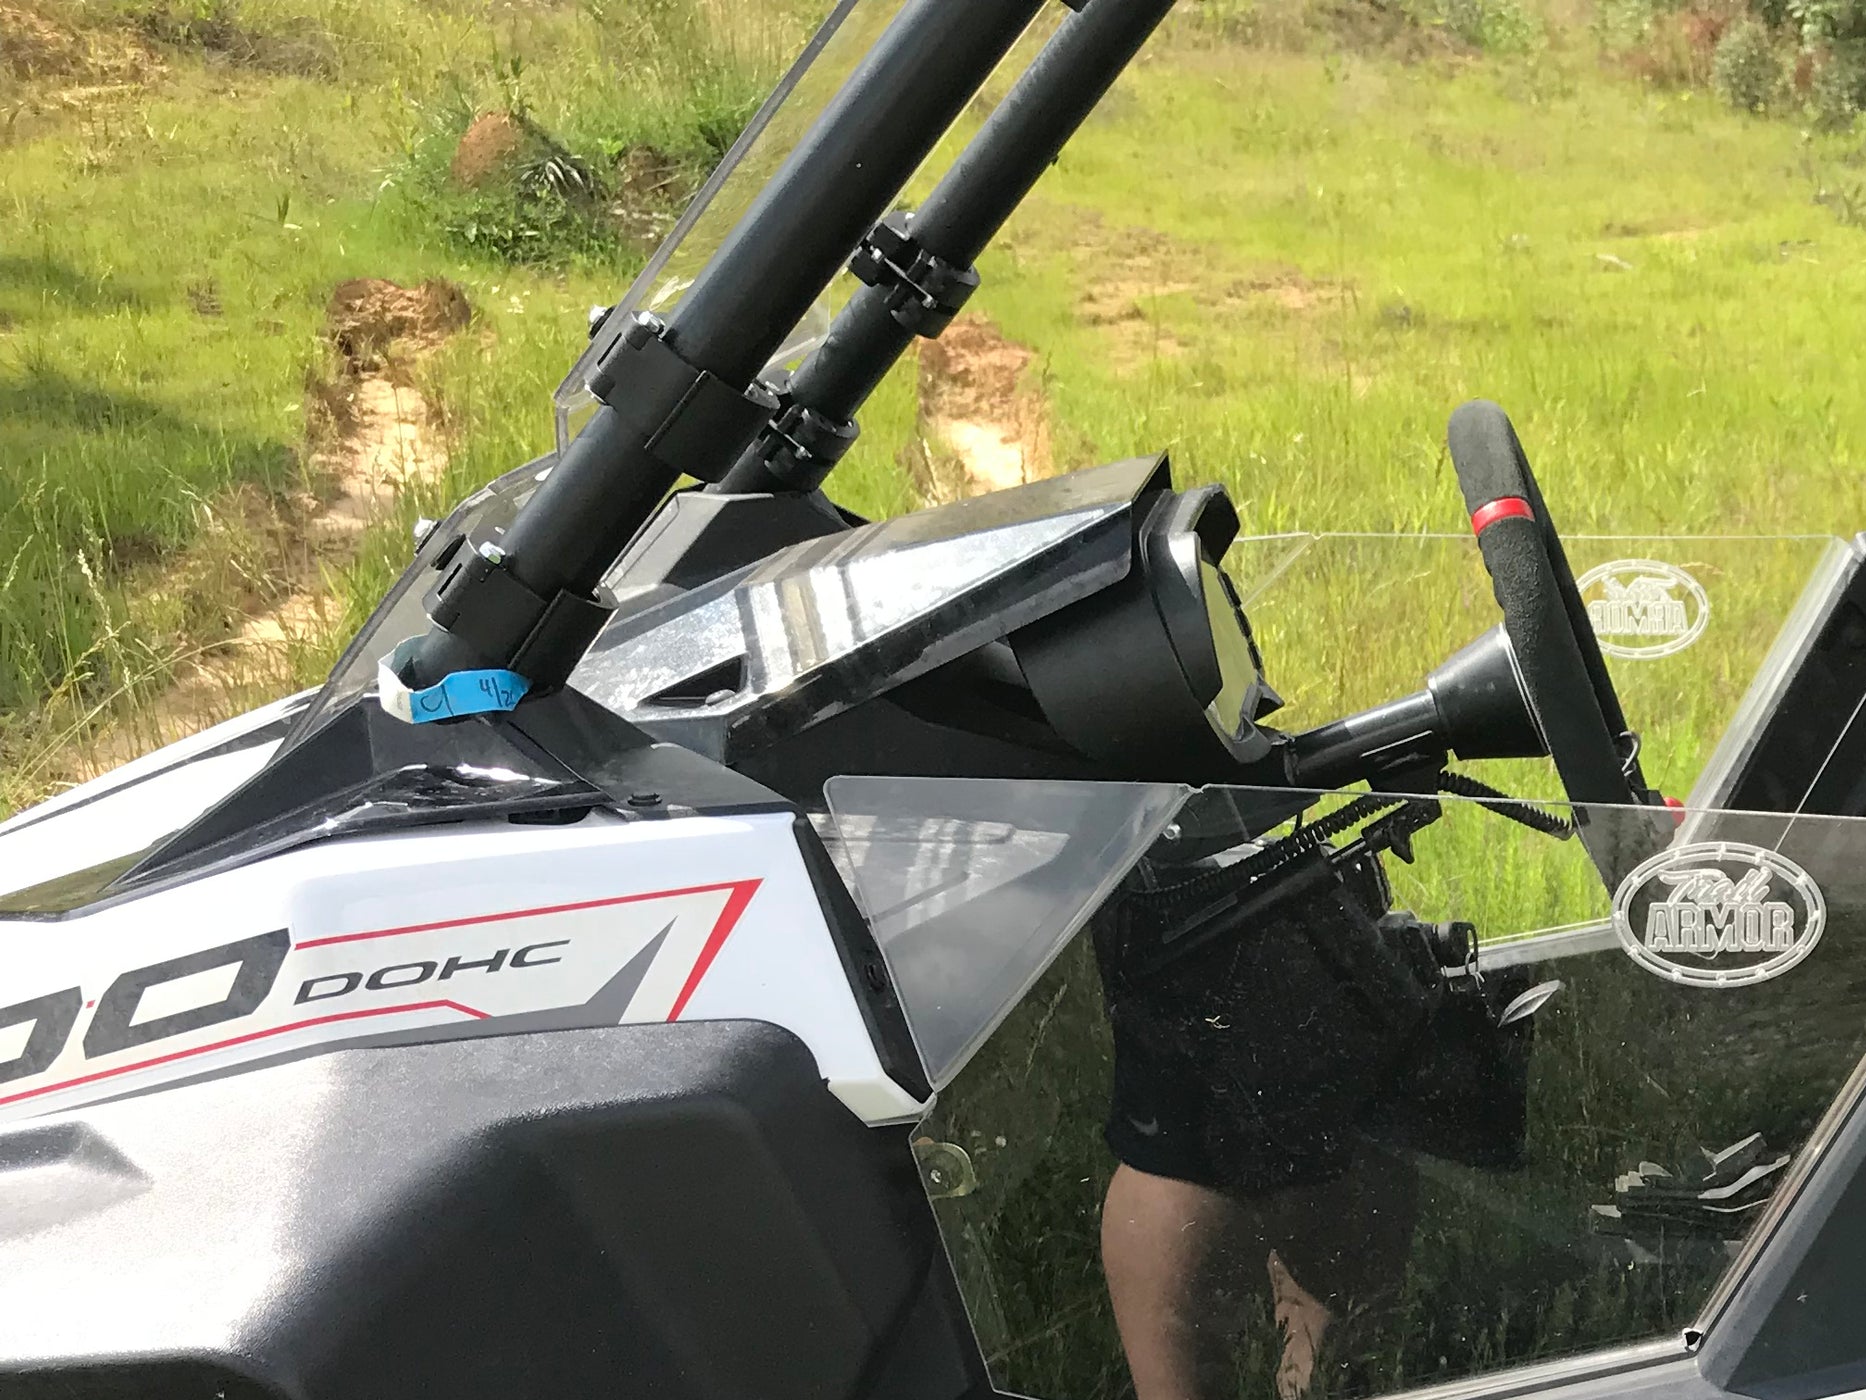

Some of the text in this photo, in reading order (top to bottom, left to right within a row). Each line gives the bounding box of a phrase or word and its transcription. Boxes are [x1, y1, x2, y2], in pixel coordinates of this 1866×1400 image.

[1657, 866, 1774, 904] Trail
[1644, 901, 1796, 953] ARMOR
[293, 939, 571, 1005] DOHC
